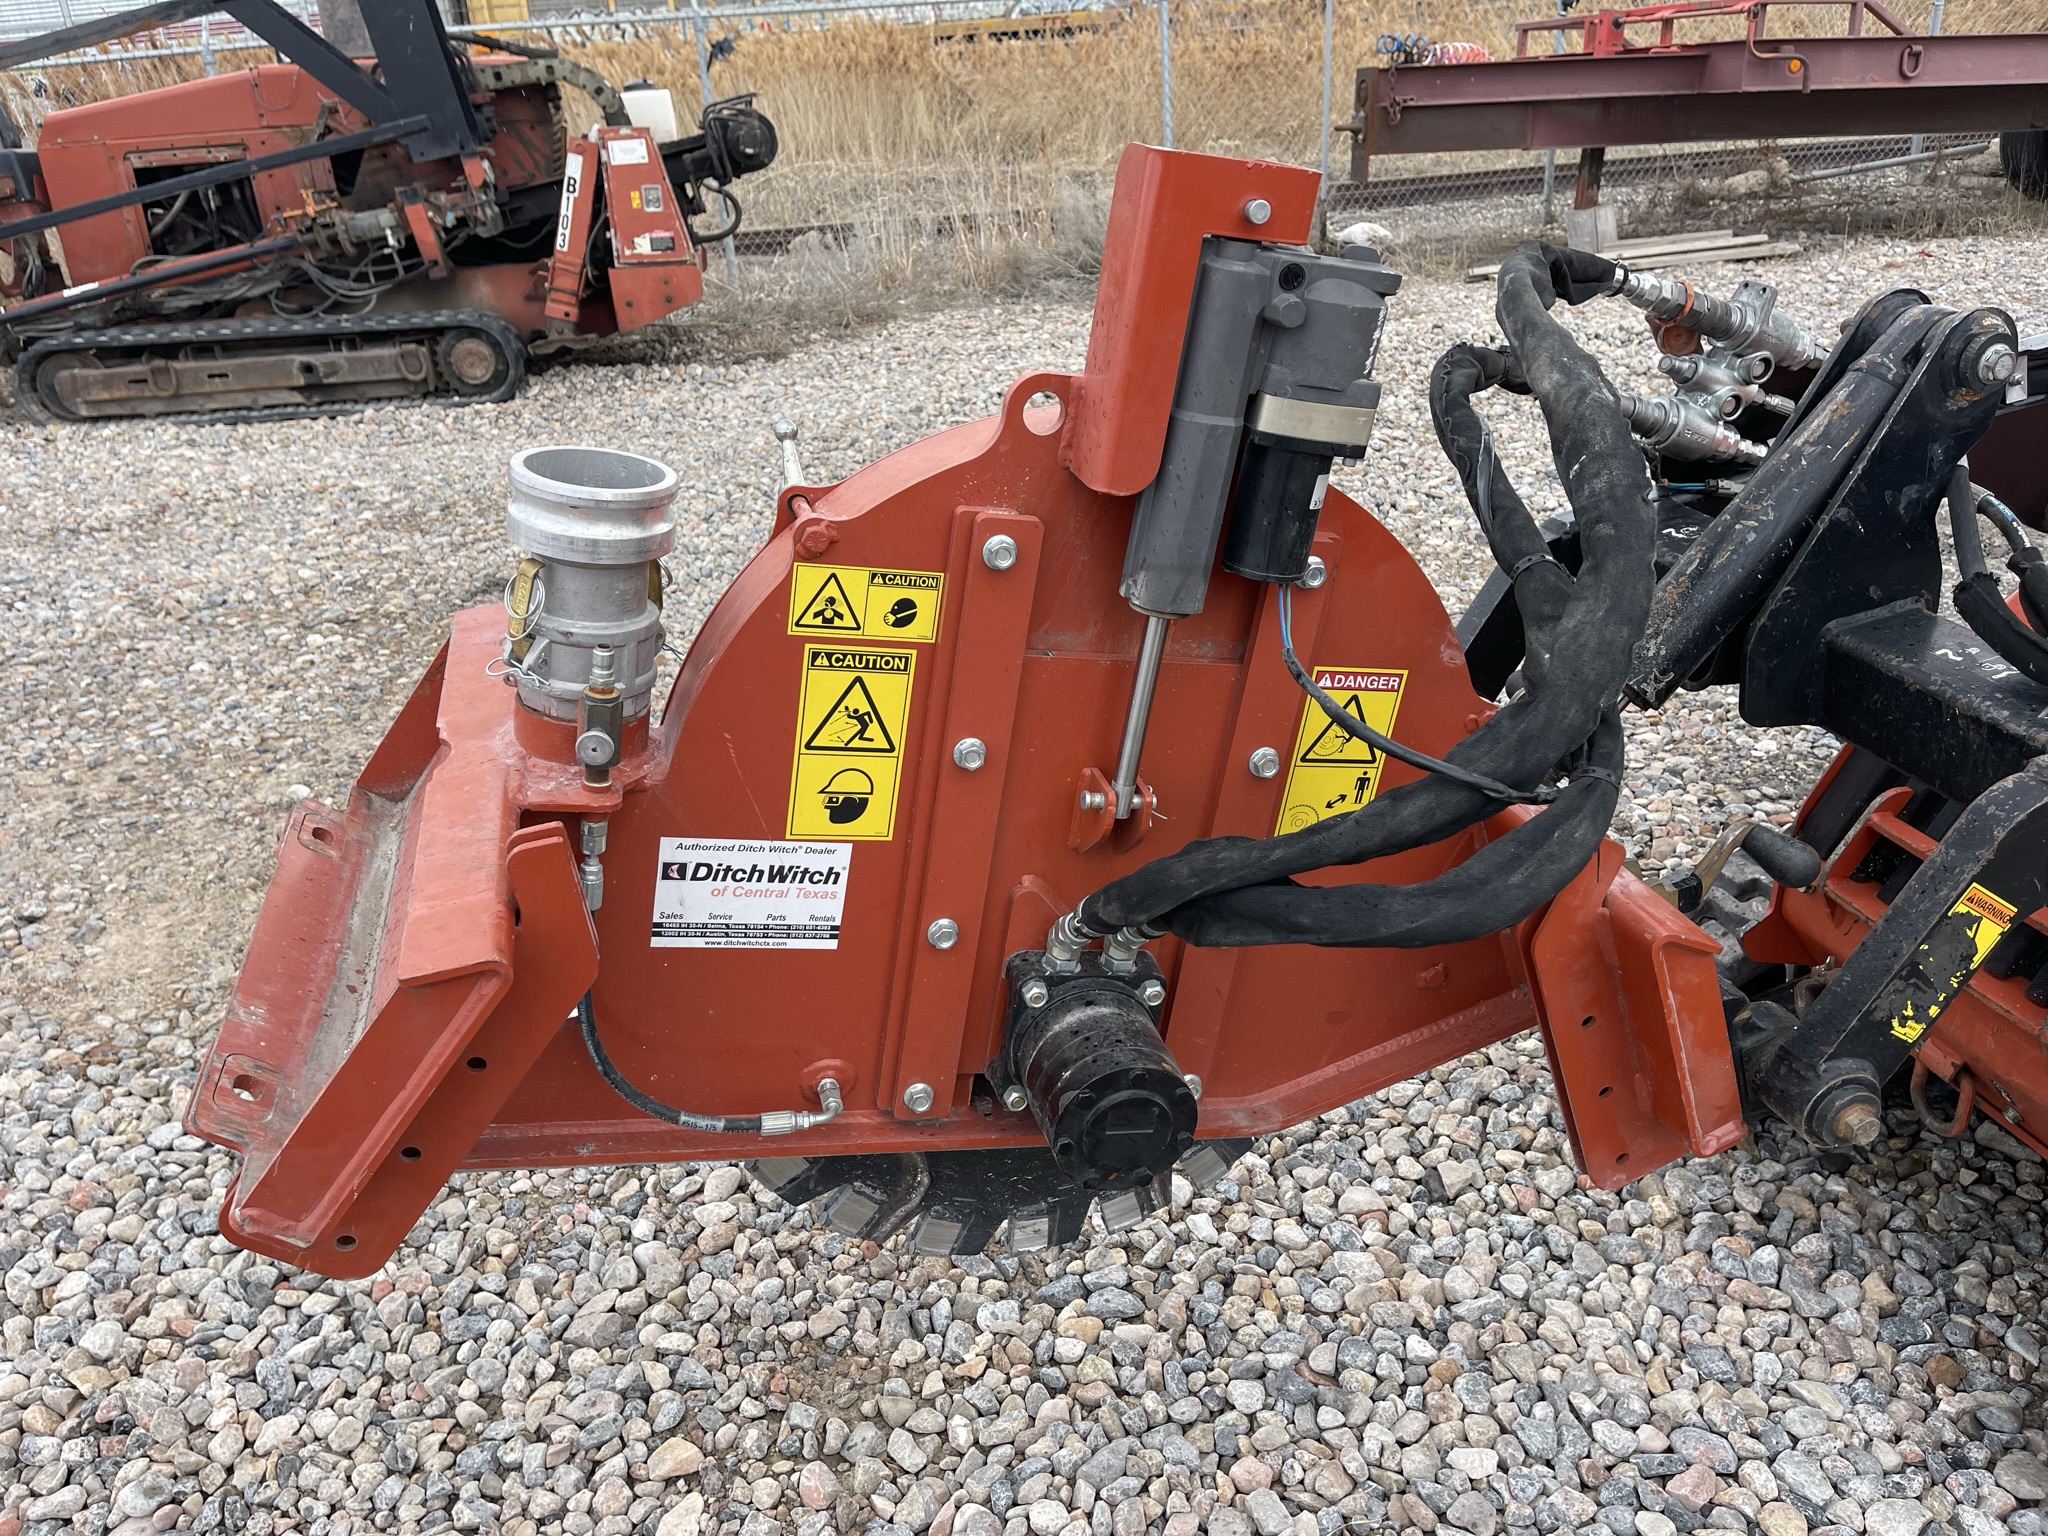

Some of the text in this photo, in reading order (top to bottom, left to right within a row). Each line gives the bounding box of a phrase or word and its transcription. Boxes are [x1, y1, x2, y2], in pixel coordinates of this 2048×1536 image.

[885, 574, 937, 588] CAUTION
[831, 653, 906, 671] CAUTION
[1333, 674, 1400, 690] DANGER
[675, 842, 735, 852] Authorized
[737, 844, 766, 853] Ditch
[804, 846, 837, 855] Dealer
[710, 885, 839, 900] of Central Texas
[658, 911, 836, 923] Sales Service Parts Rentals
[1974, 896, 2011, 924] WARNING
[704, 939, 788, 947] www.ditchwitchctx.com
